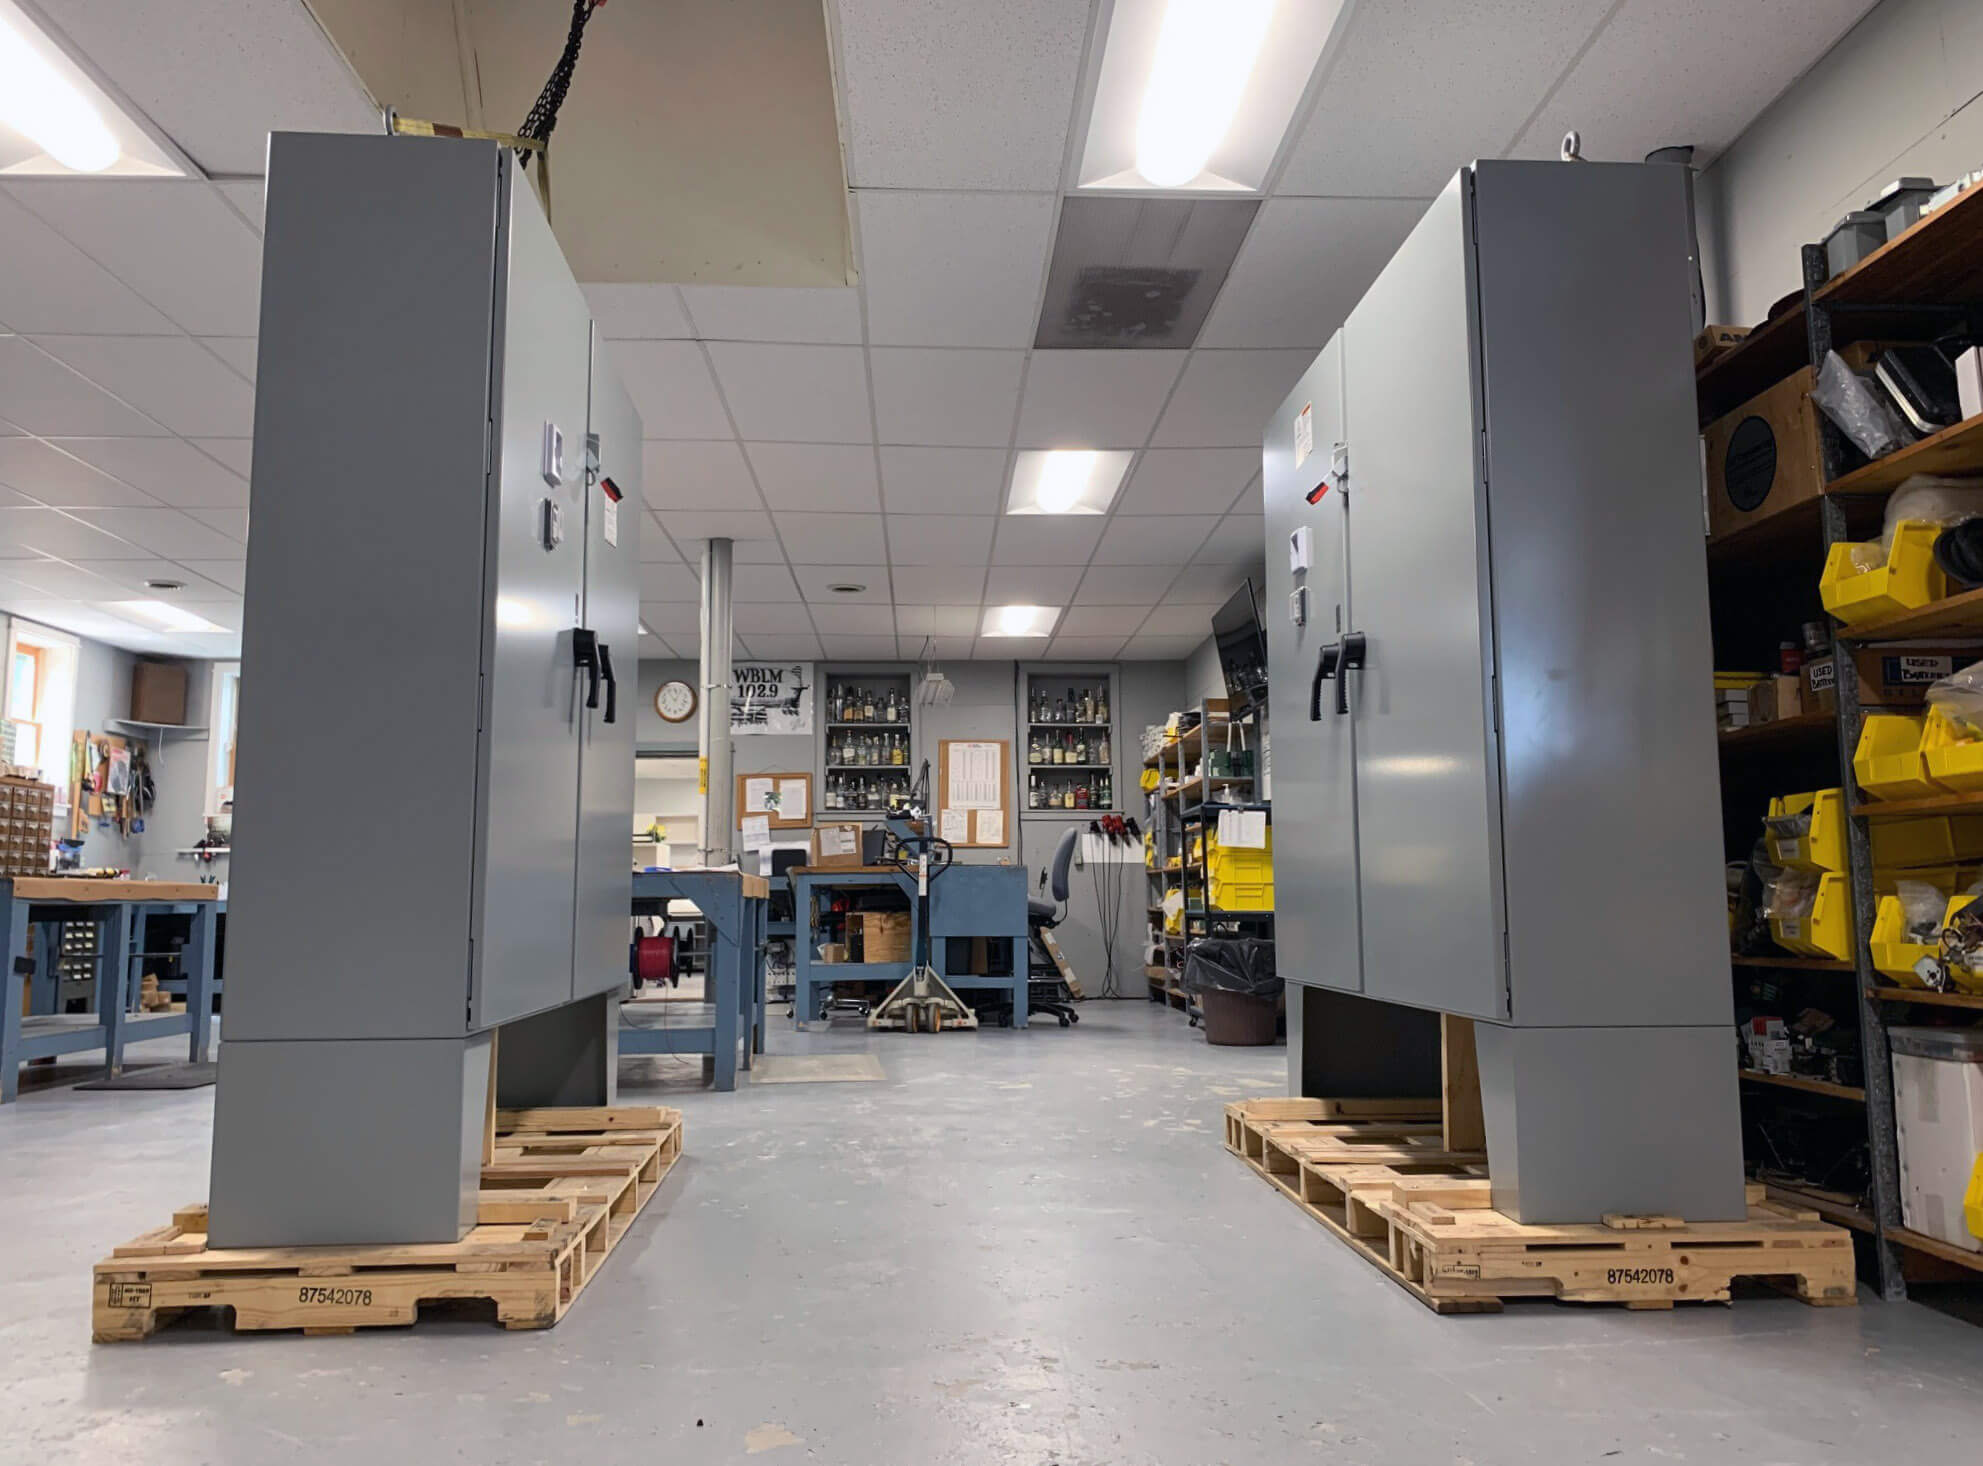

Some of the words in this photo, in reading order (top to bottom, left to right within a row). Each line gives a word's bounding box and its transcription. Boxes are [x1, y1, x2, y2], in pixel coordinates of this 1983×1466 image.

[733, 668, 783, 683] WBLM
[1813, 665, 1833, 678] USED
[738, 684, 778, 698] 102.9
[1607, 1267, 1675, 1285] 87542078
[298, 1287, 373, 1306] 87542078
